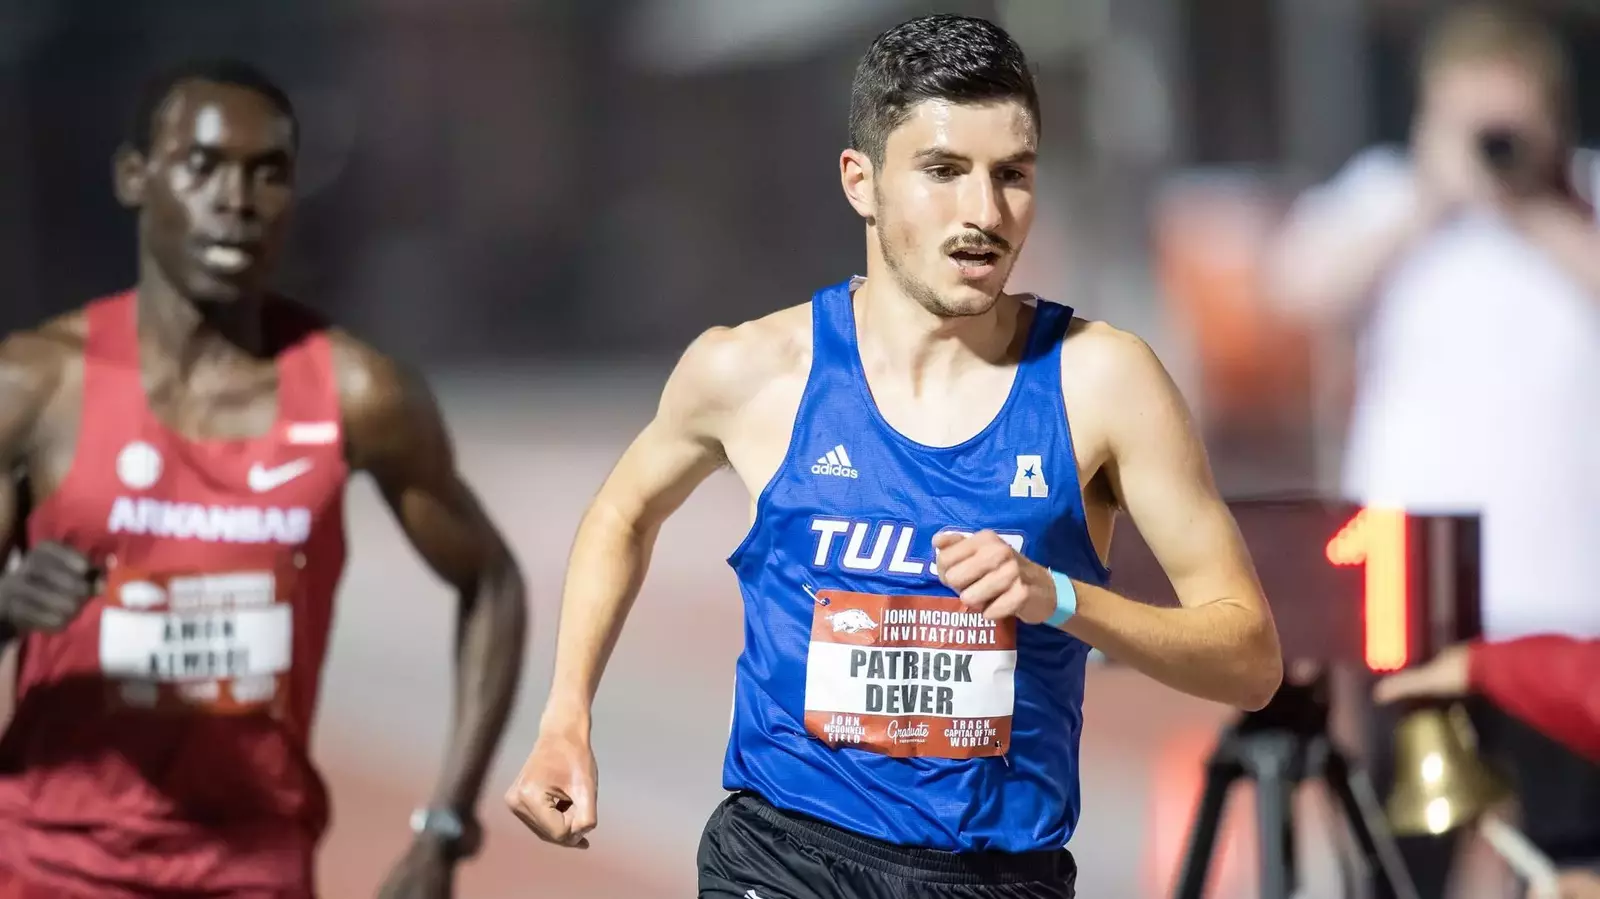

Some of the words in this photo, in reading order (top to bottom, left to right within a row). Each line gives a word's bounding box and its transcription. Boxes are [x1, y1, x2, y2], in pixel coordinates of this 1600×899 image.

[811, 463, 859, 480] adidas
[809, 517, 1027, 577] TUL
[1326, 504, 1408, 672] 1
[883, 608, 918, 625] JOHN
[883, 626, 997, 645] INVITATIONAL
[850, 648, 973, 683] PATRICK
[865, 683, 954, 716] DEVER
[830, 714, 861, 727] JOHN
[952, 719, 990, 730] TRACK
[823, 723, 865, 736] MCDONNELL
[828, 732, 861, 744] FIELD
[887, 719, 930, 745] Graduate
[944, 728, 973, 738] CAPITAL
[974, 729, 984, 737] OF
[984, 728, 997, 736] THE
[950, 736, 990, 747] WORLD
